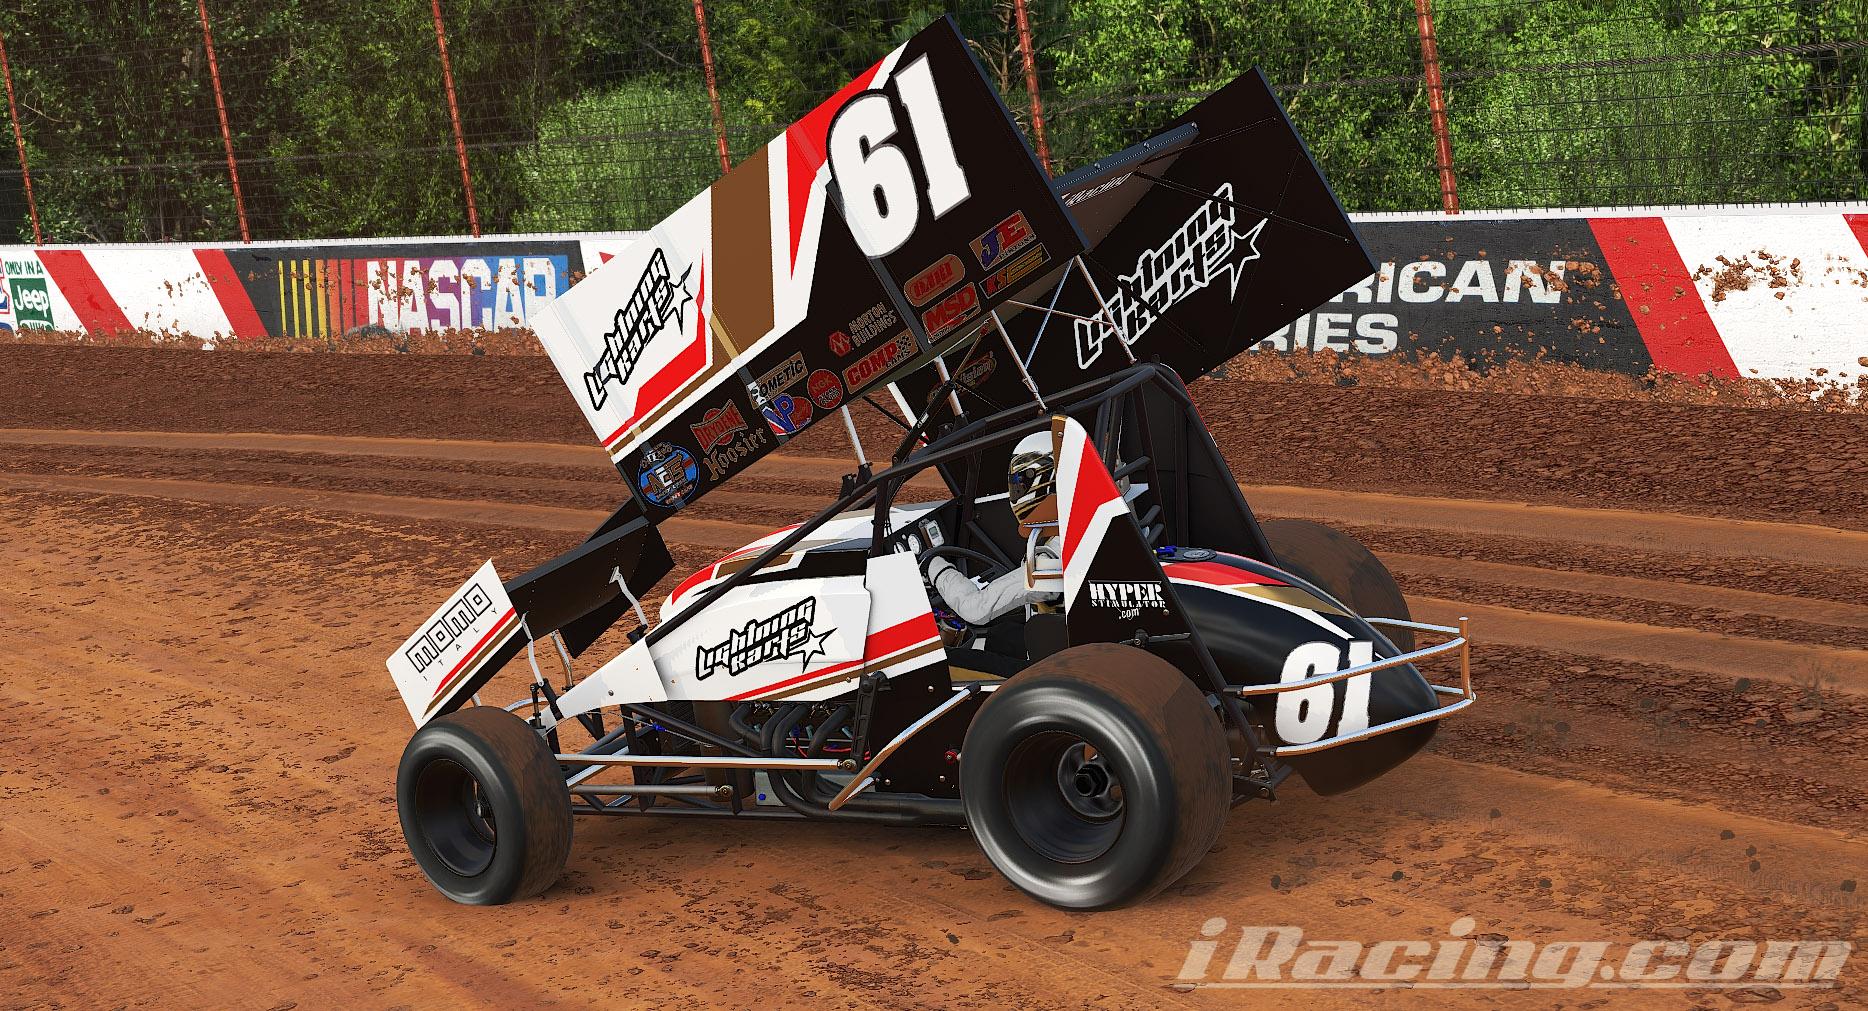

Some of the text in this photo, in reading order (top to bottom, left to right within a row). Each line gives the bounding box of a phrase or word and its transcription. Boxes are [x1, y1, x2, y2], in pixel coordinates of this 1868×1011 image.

[829, 52, 971, 259] 61
[980, 213, 1027, 269] JE
[25, 261, 35, 275] IN
[36, 260, 44, 274] A
[14, 284, 49, 318] Jeep
[366, 257, 557, 334] NASCAR
[925, 286, 976, 333] MSD
[848, 302, 887, 334] MORTON
[851, 310, 897, 347] BUILDINGS
[847, 343, 898, 385] COMP
[703, 428, 766, 481] Hoosier
[1089, 583, 1163, 600] HYPER
[1091, 600, 1166, 608] STIMULATOR
[1274, 638, 1374, 744] 61
